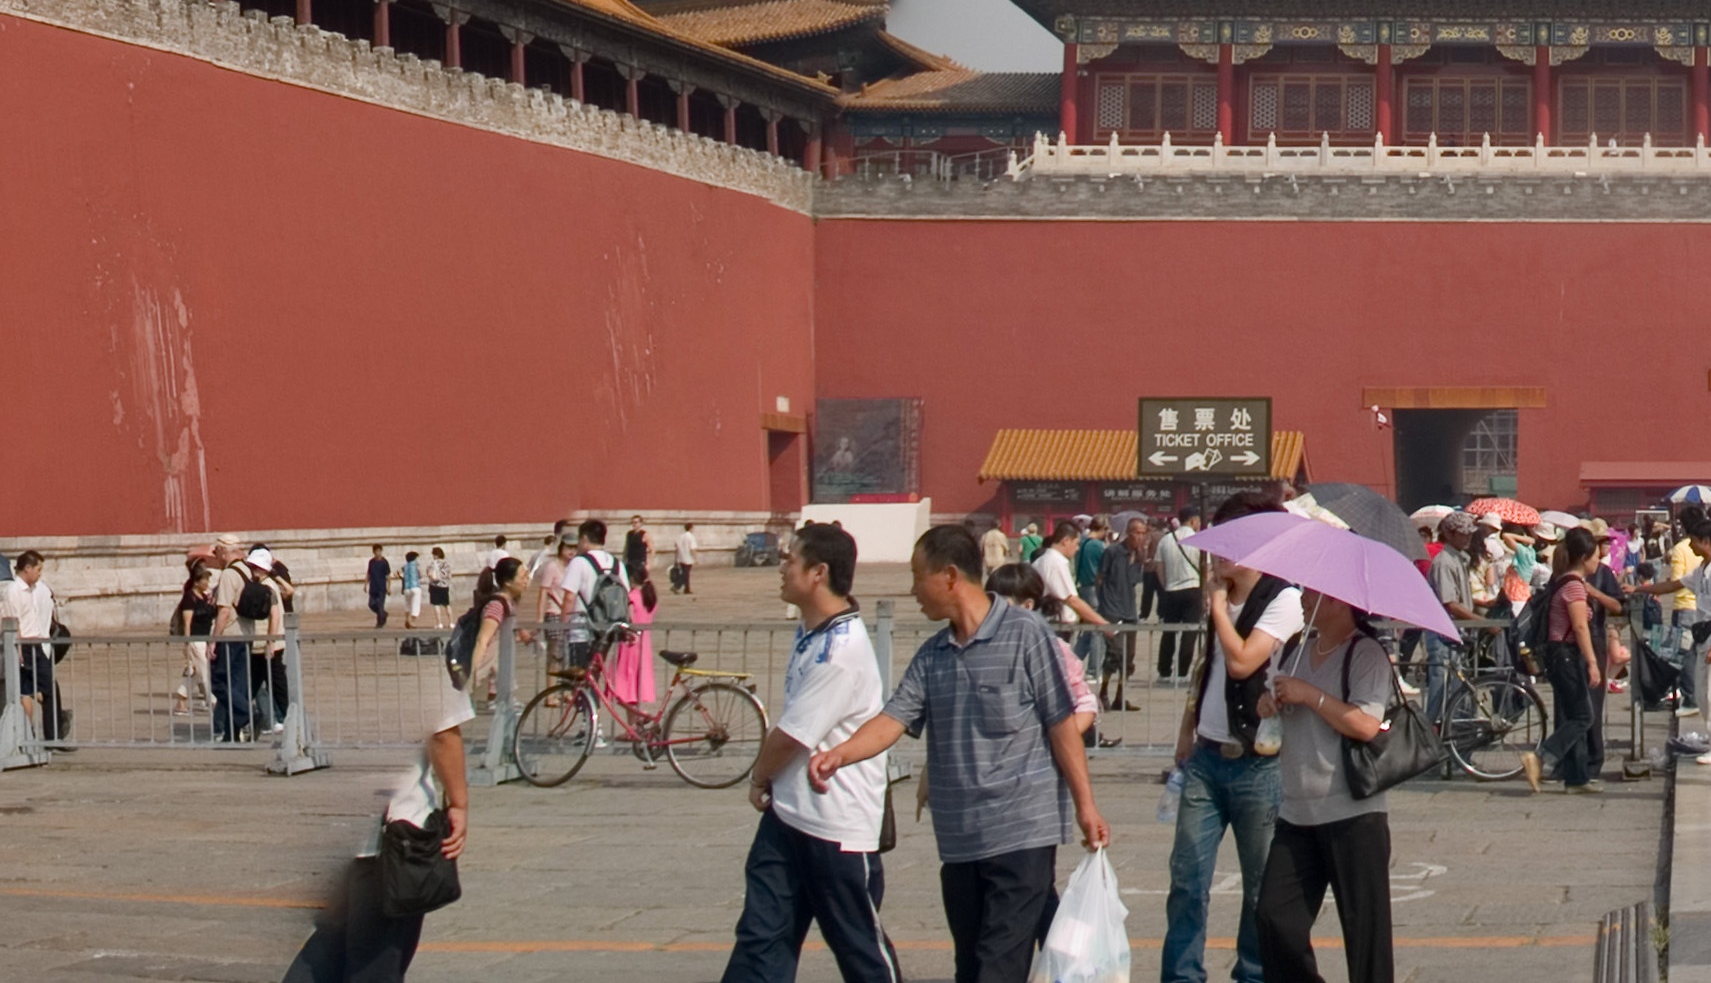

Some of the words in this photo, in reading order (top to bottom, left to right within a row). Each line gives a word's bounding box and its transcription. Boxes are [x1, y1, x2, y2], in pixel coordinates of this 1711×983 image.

[1158, 408, 1252, 430] 售票处
[1154, 433, 1199, 447] TICKET
[1206, 433, 1254, 447] OFFICE
